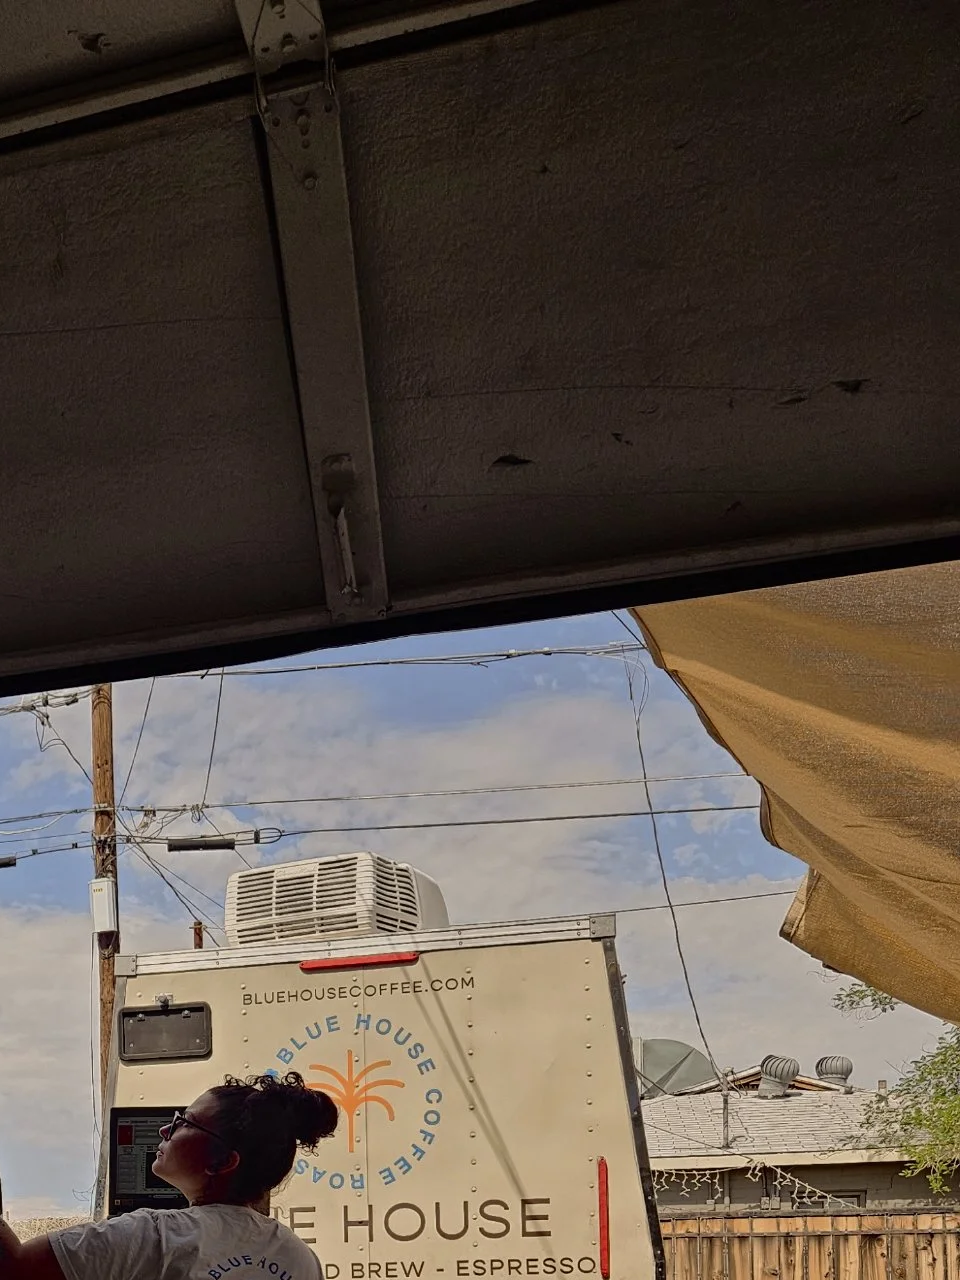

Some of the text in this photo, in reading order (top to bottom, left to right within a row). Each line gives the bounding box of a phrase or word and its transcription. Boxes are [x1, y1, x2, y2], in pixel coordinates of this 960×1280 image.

[243, 976, 475, 1006] BLUEHOUSECOFFEE.COM
[276, 1013, 443, 1190] BLUE HOUSE COFFEE ROAS
[343, 1197, 552, 1243] HOUSE
[208, 1255, 253, 1280] BLUE
[325, 1263, 340, 1280] D
[351, 1260, 425, 1279] BREW
[456, 1256, 597, 1277] ESPRESSO
